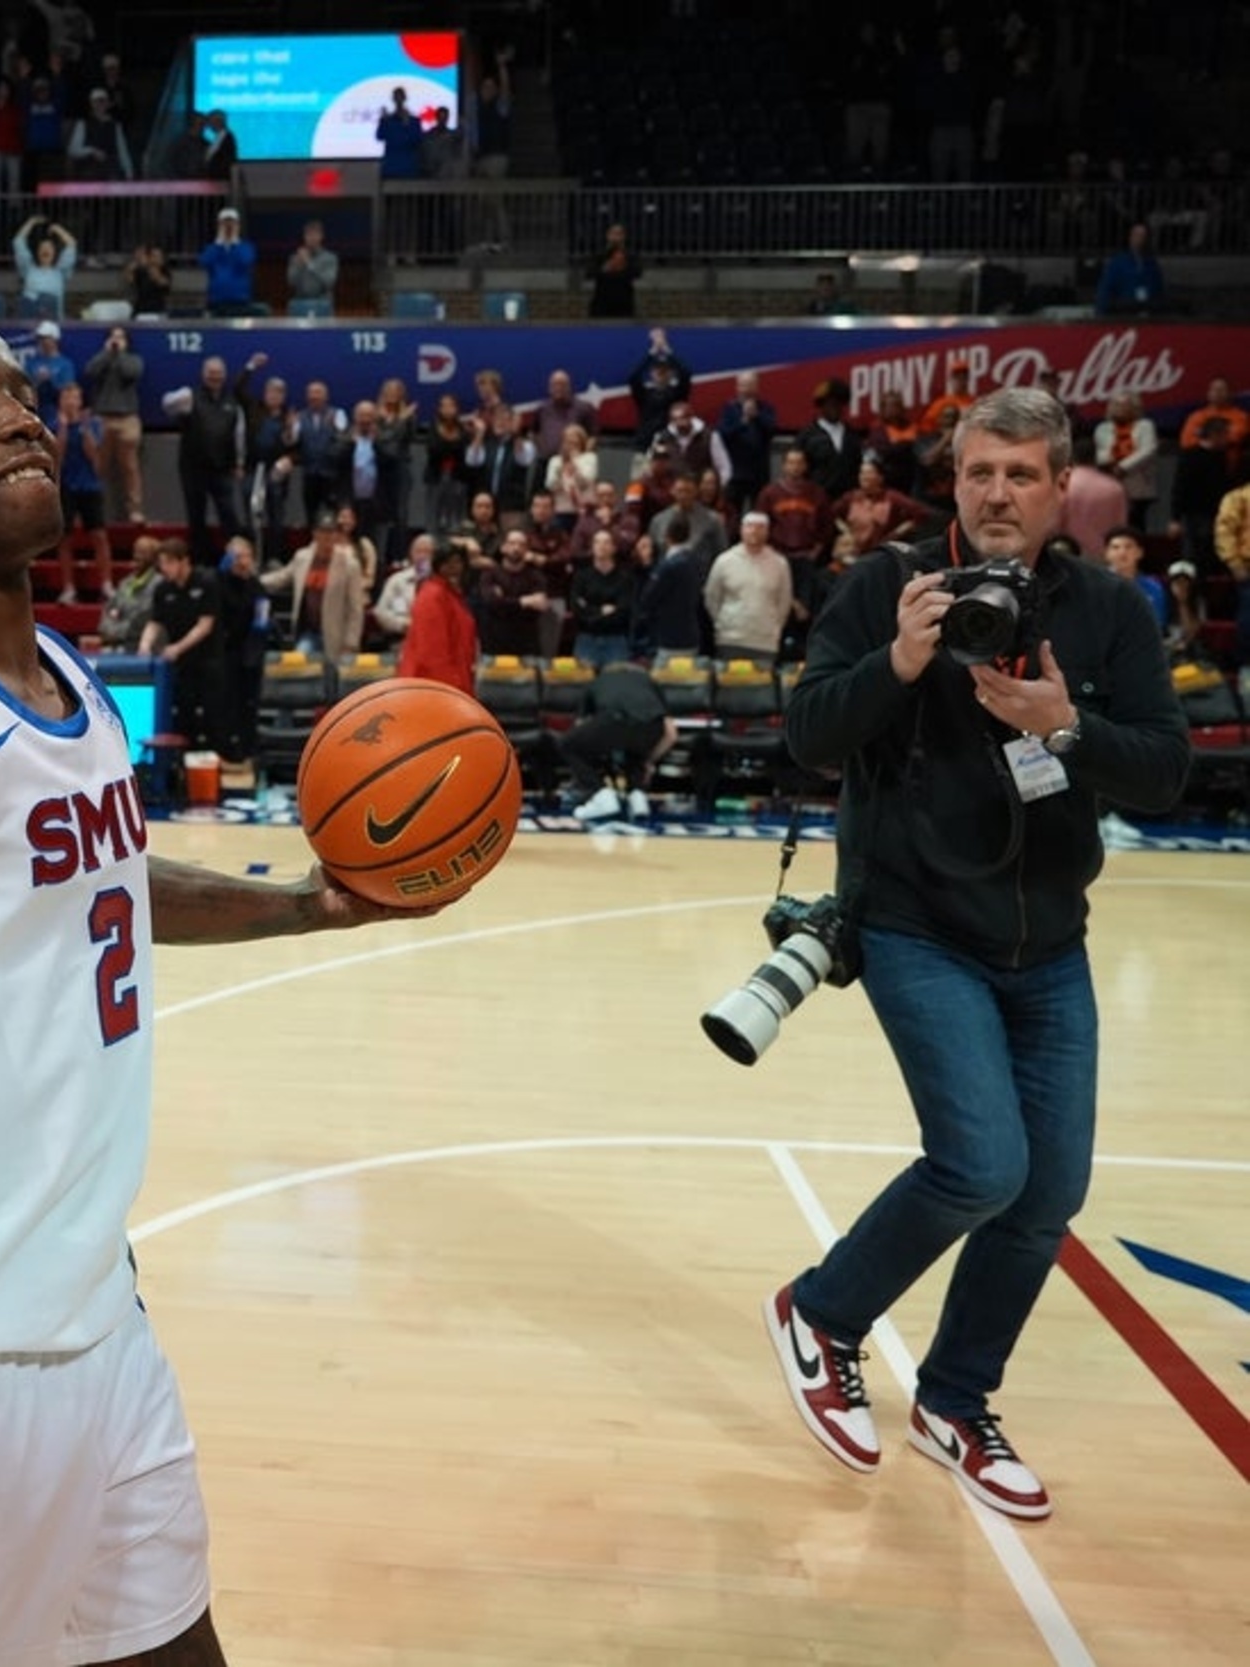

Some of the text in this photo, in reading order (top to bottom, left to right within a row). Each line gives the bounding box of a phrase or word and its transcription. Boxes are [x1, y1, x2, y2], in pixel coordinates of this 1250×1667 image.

[168, 332, 203, 352] 112
[352, 332, 387, 352] 113
[851, 353, 936, 416] PONY
[25, 774, 148, 888] SMU
[87, 886, 140, 1048] 2
